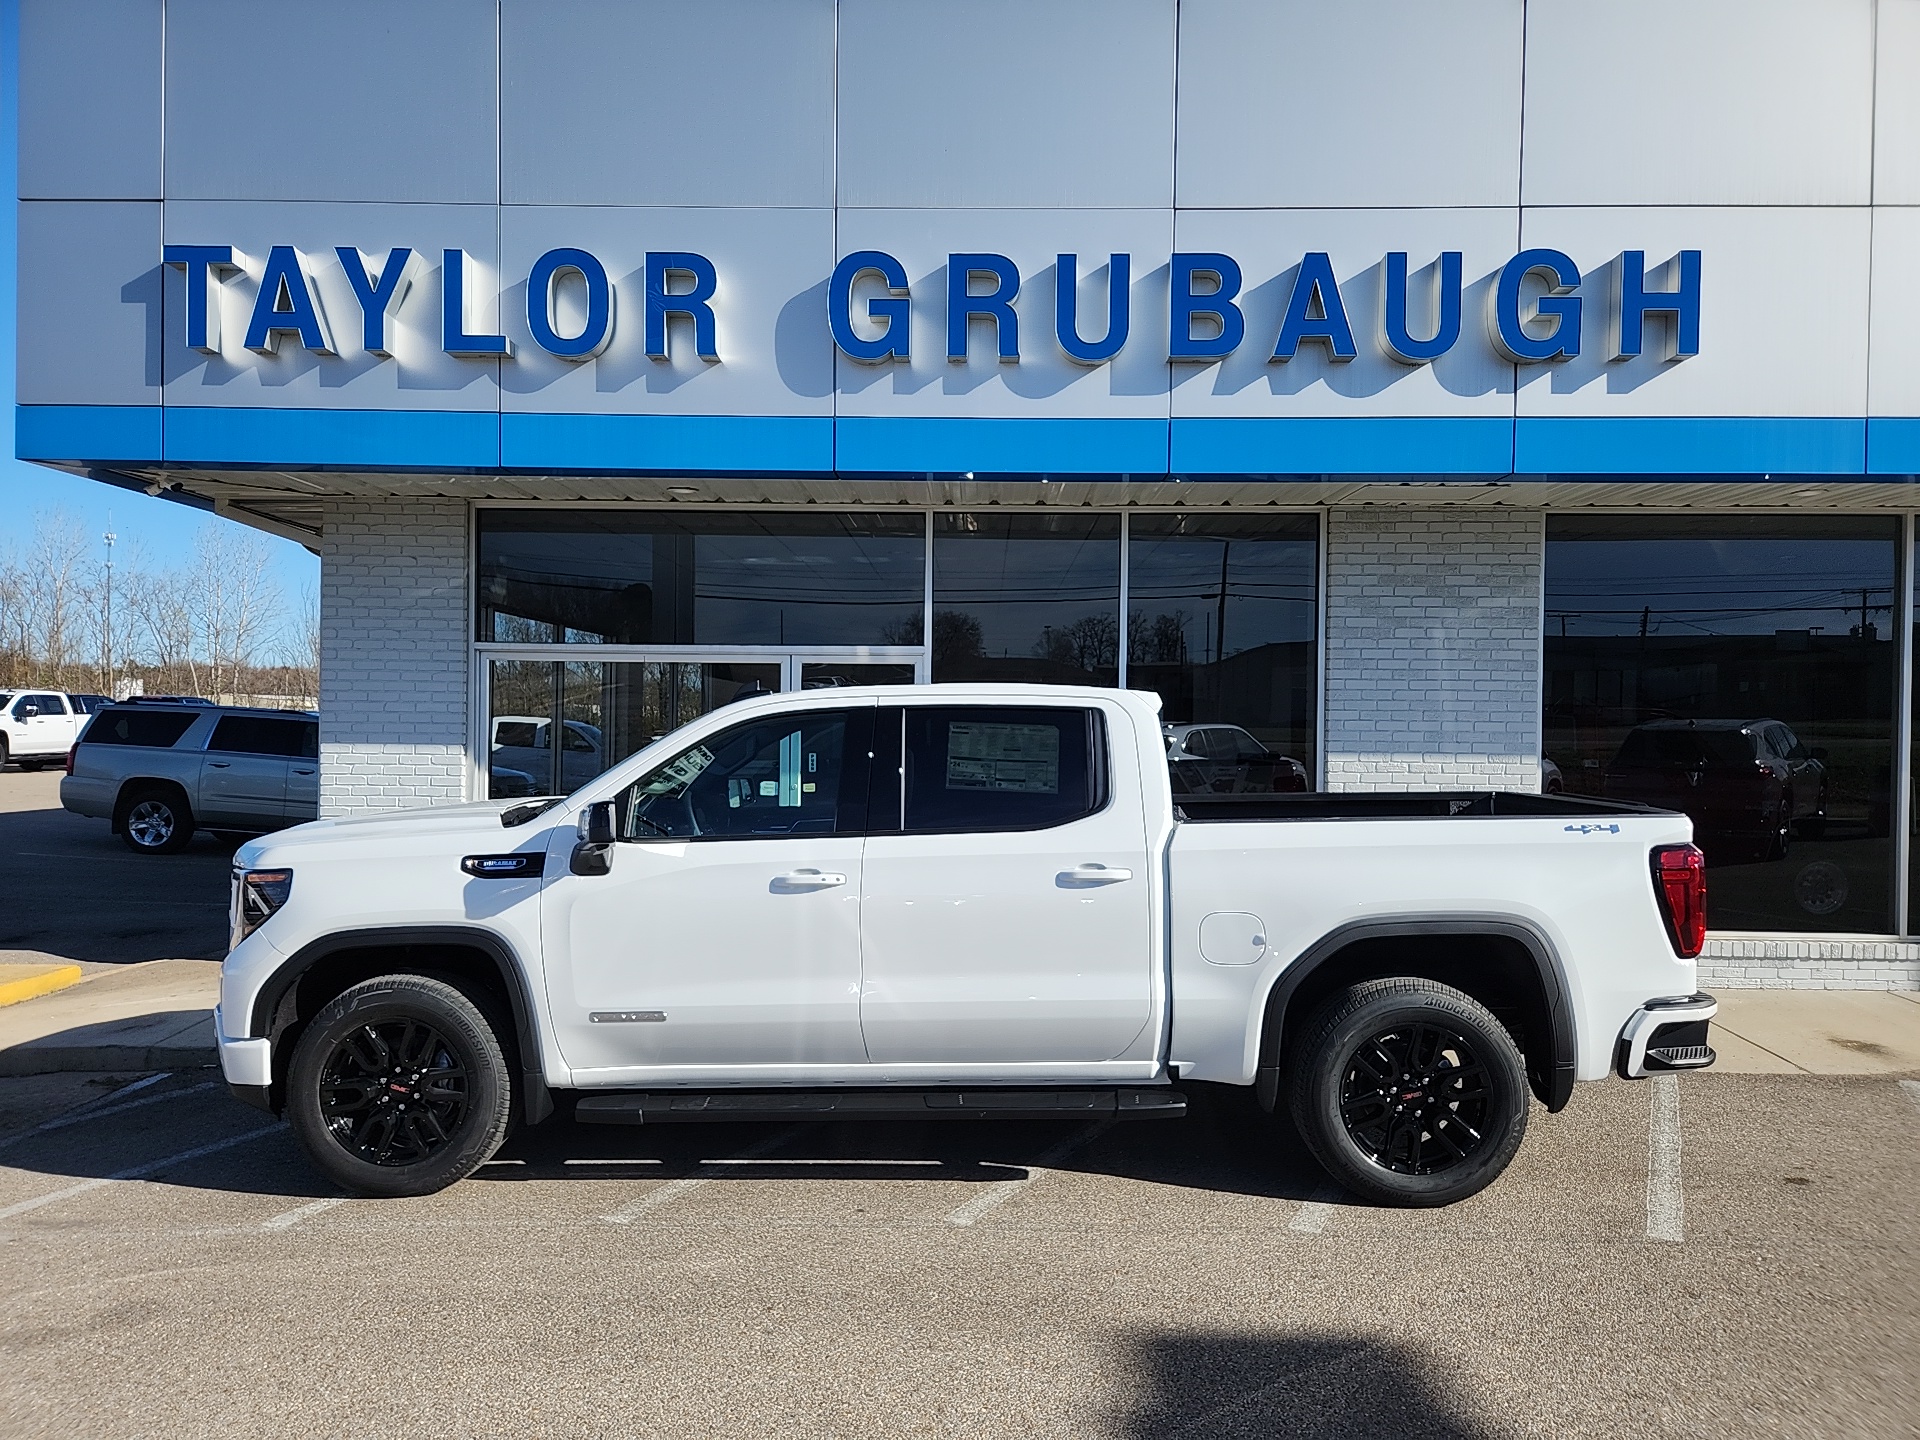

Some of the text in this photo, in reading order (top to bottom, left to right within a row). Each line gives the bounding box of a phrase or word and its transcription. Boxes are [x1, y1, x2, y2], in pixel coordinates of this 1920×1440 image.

[163, 245, 1701, 363] TAYLOR GRUBAUGH
[1423, 996, 1497, 1039] BRIDGESTONE
